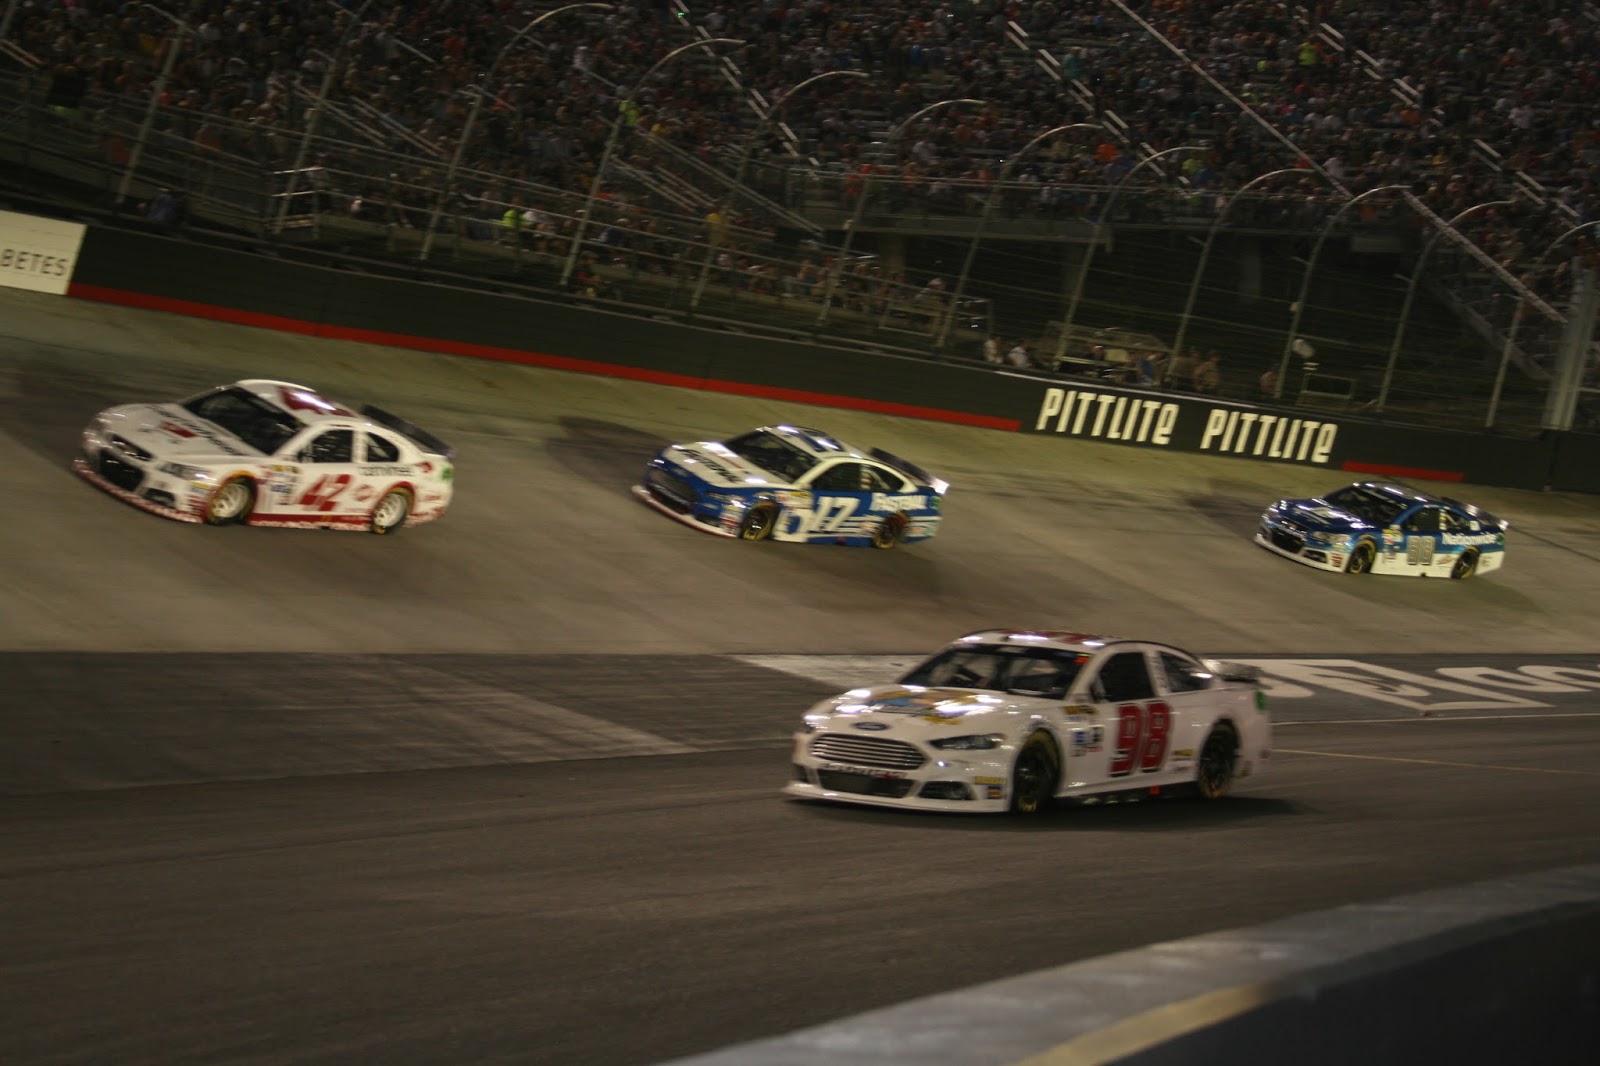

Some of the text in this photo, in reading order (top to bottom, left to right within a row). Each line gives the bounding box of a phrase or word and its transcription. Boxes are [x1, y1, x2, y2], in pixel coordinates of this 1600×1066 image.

[298, 473, 353, 512] 42
[812, 495, 862, 533] 17
[1109, 700, 1174, 777] 98
